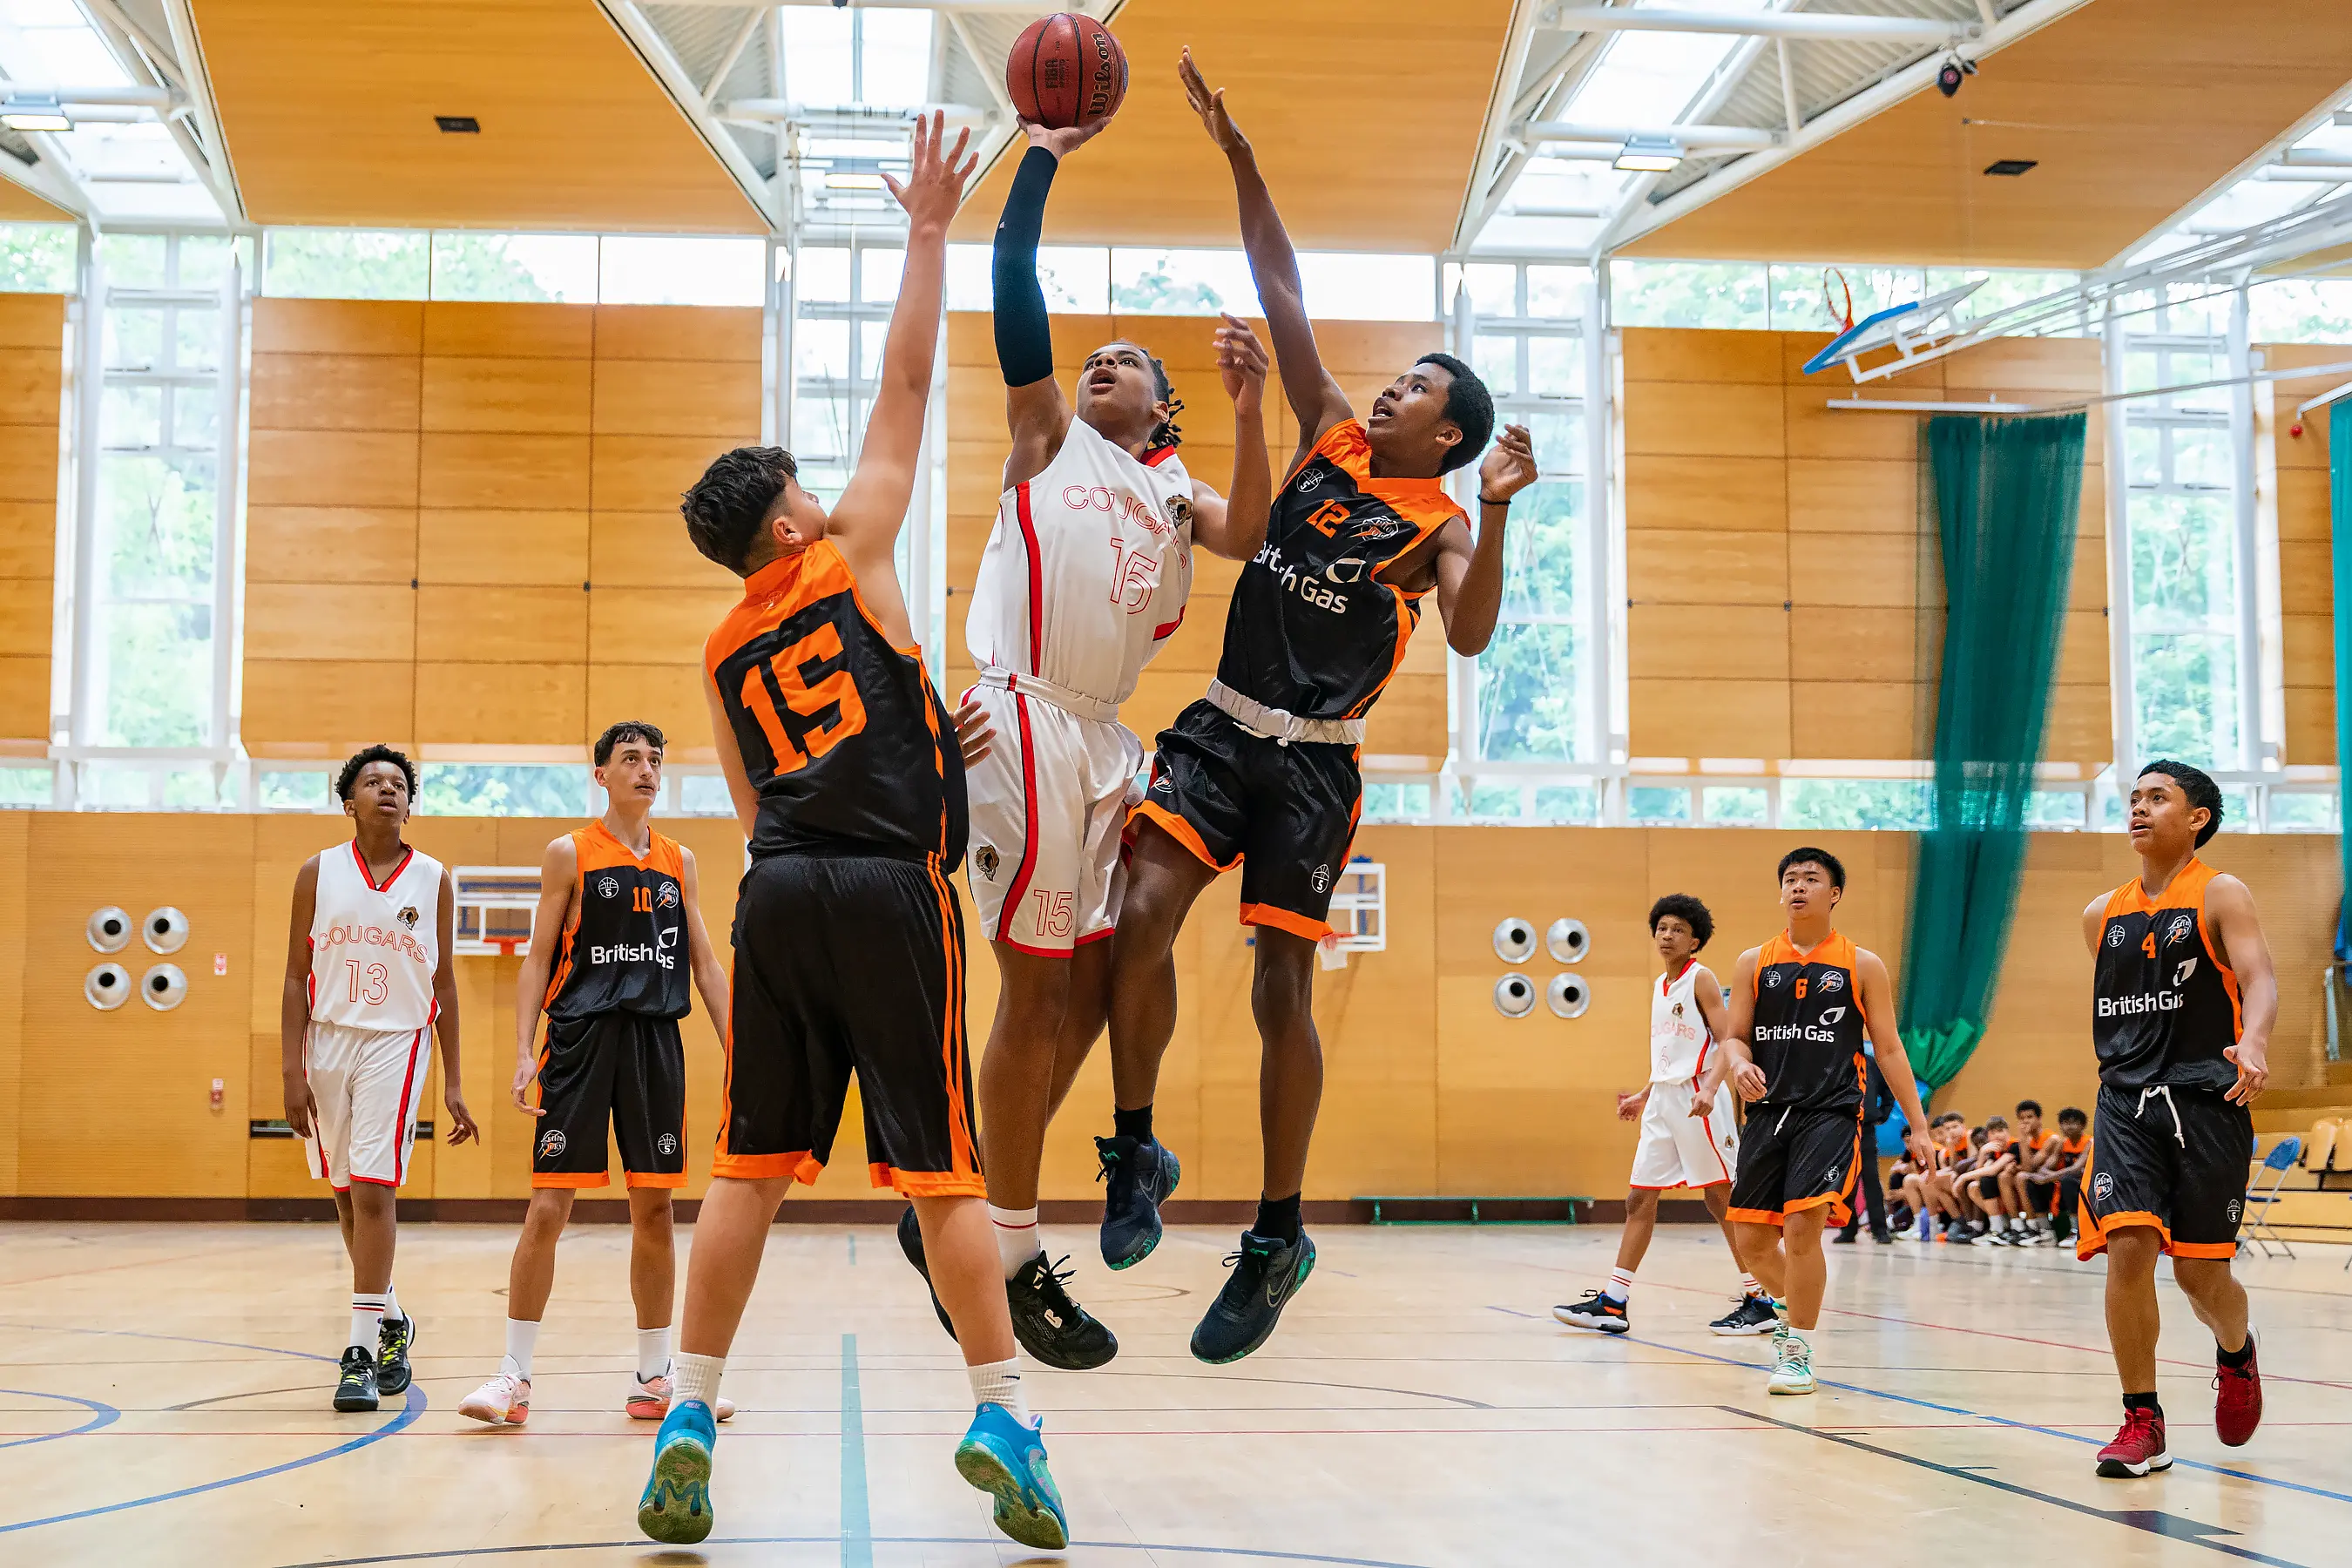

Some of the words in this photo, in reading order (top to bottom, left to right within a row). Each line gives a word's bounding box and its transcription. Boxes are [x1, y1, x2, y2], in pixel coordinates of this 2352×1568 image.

[1087, 32, 1112, 117] Wilson
[1306, 498, 1351, 539] 12
[1110, 537, 1158, 614] 15
[1301, 576, 1348, 614] Gas
[740, 621, 868, 777] 15
[632, 887, 653, 913] 10
[1033, 889, 1073, 937] 15
[318, 925, 428, 963] COUGARS
[591, 943, 653, 964] British
[2141, 932, 2156, 959] 4
[345, 959, 389, 1006] 13
[1795, 978, 1808, 999] 6
[2098, 992, 2157, 1017] British
[1755, 1023, 1801, 1042] British
[1804, 1024, 1835, 1043] Gas
